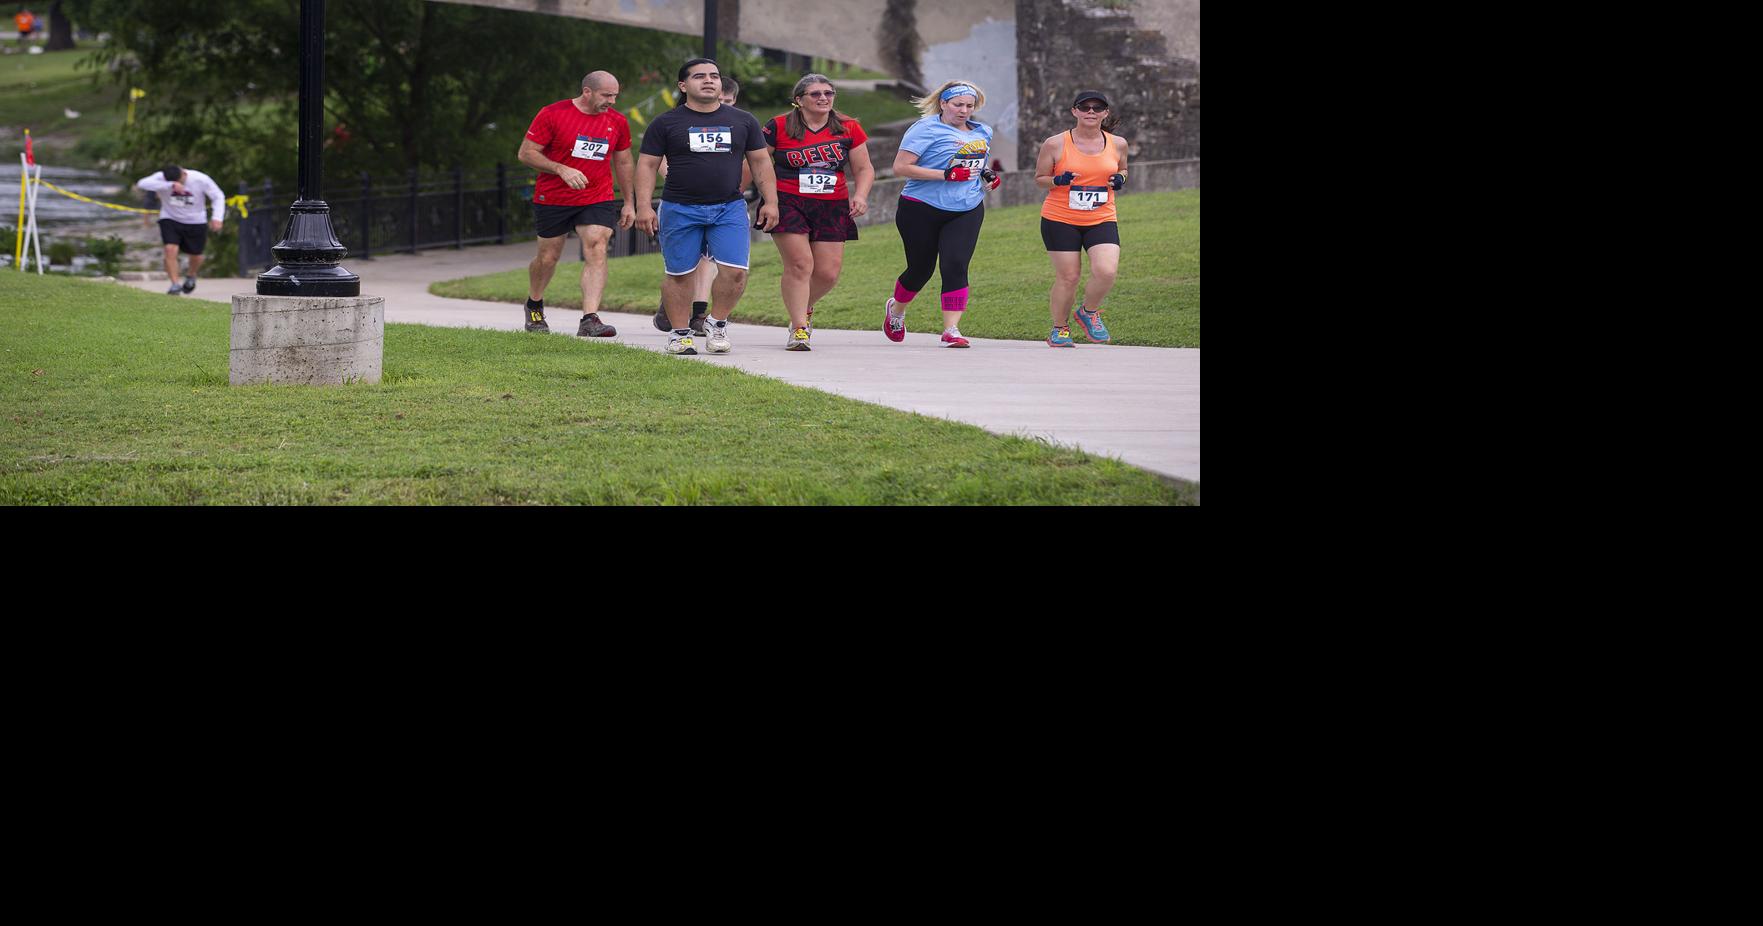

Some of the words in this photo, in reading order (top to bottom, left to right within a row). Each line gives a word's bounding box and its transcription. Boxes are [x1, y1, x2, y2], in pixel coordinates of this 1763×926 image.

[698, 133, 723, 143] 156
[581, 142, 603, 152] 207
[786, 143, 844, 167] BEEF
[807, 175, 831, 185] 132
[1077, 192, 1099, 202] 171
